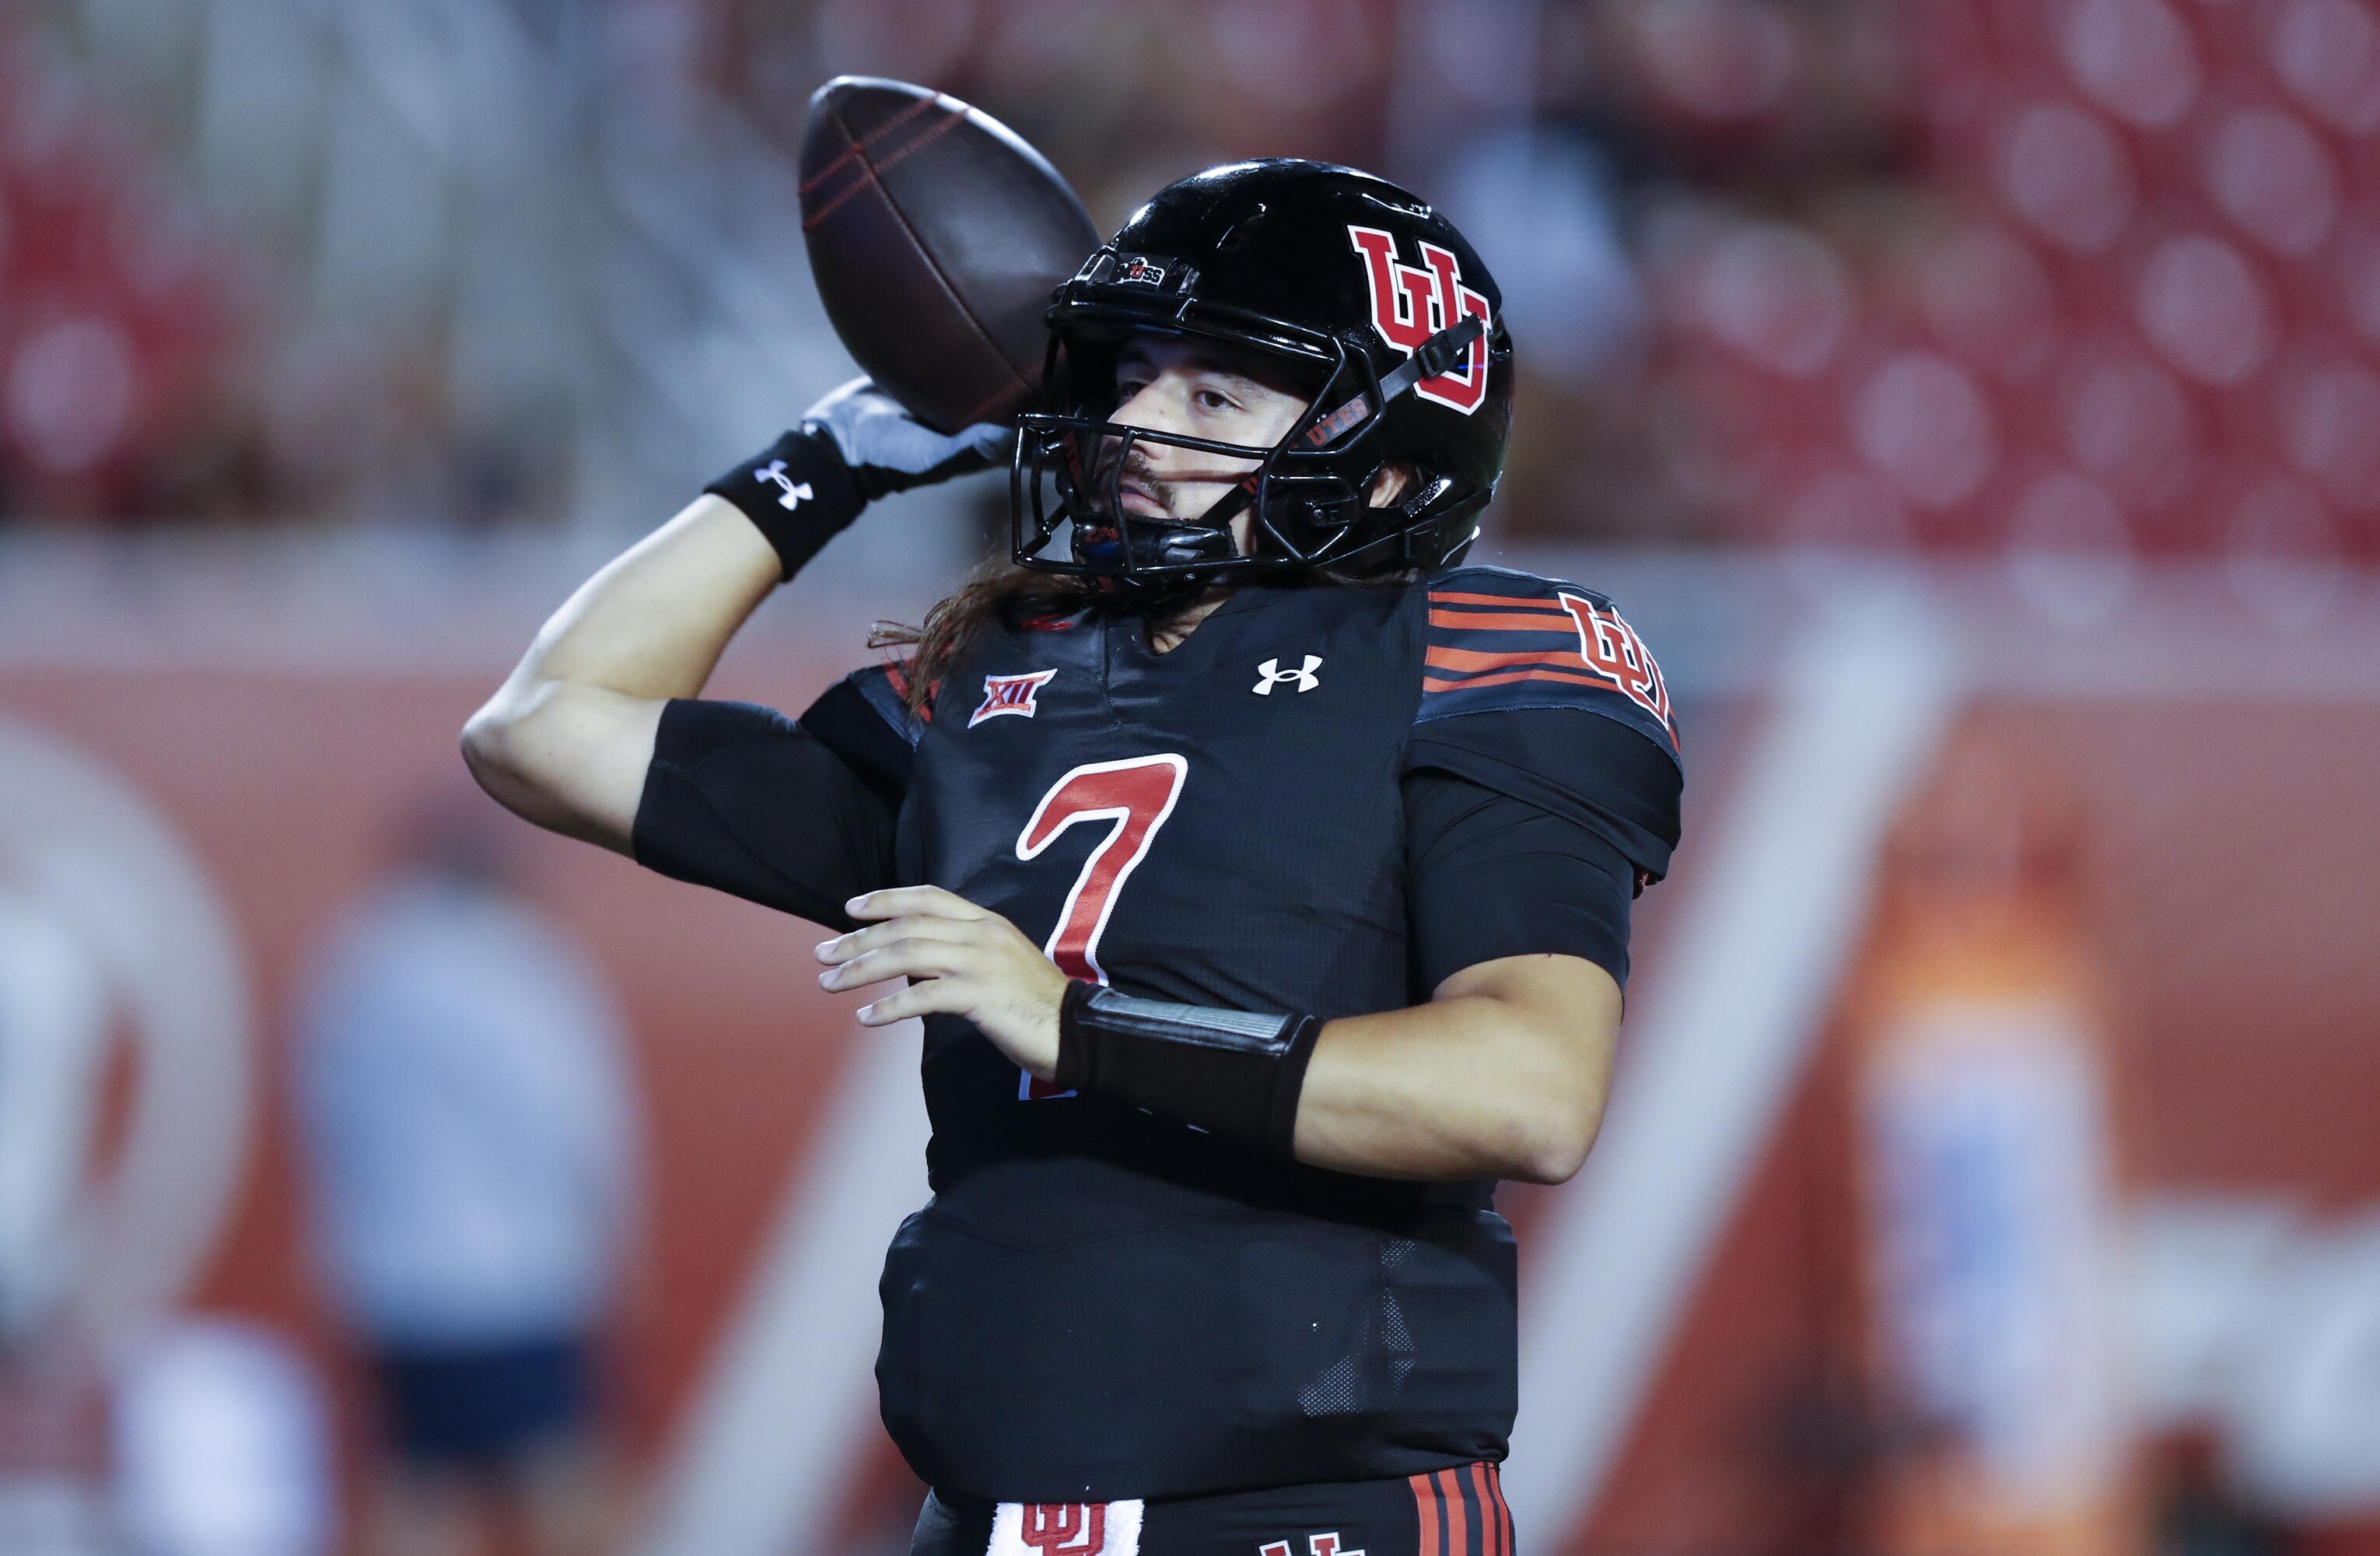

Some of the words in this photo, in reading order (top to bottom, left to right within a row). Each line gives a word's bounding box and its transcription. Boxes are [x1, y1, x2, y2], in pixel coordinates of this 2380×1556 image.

[1307, 398, 1368, 446] UTES
[972, 671, 1055, 722] XII
[1016, 753, 1188, 1101] 7
